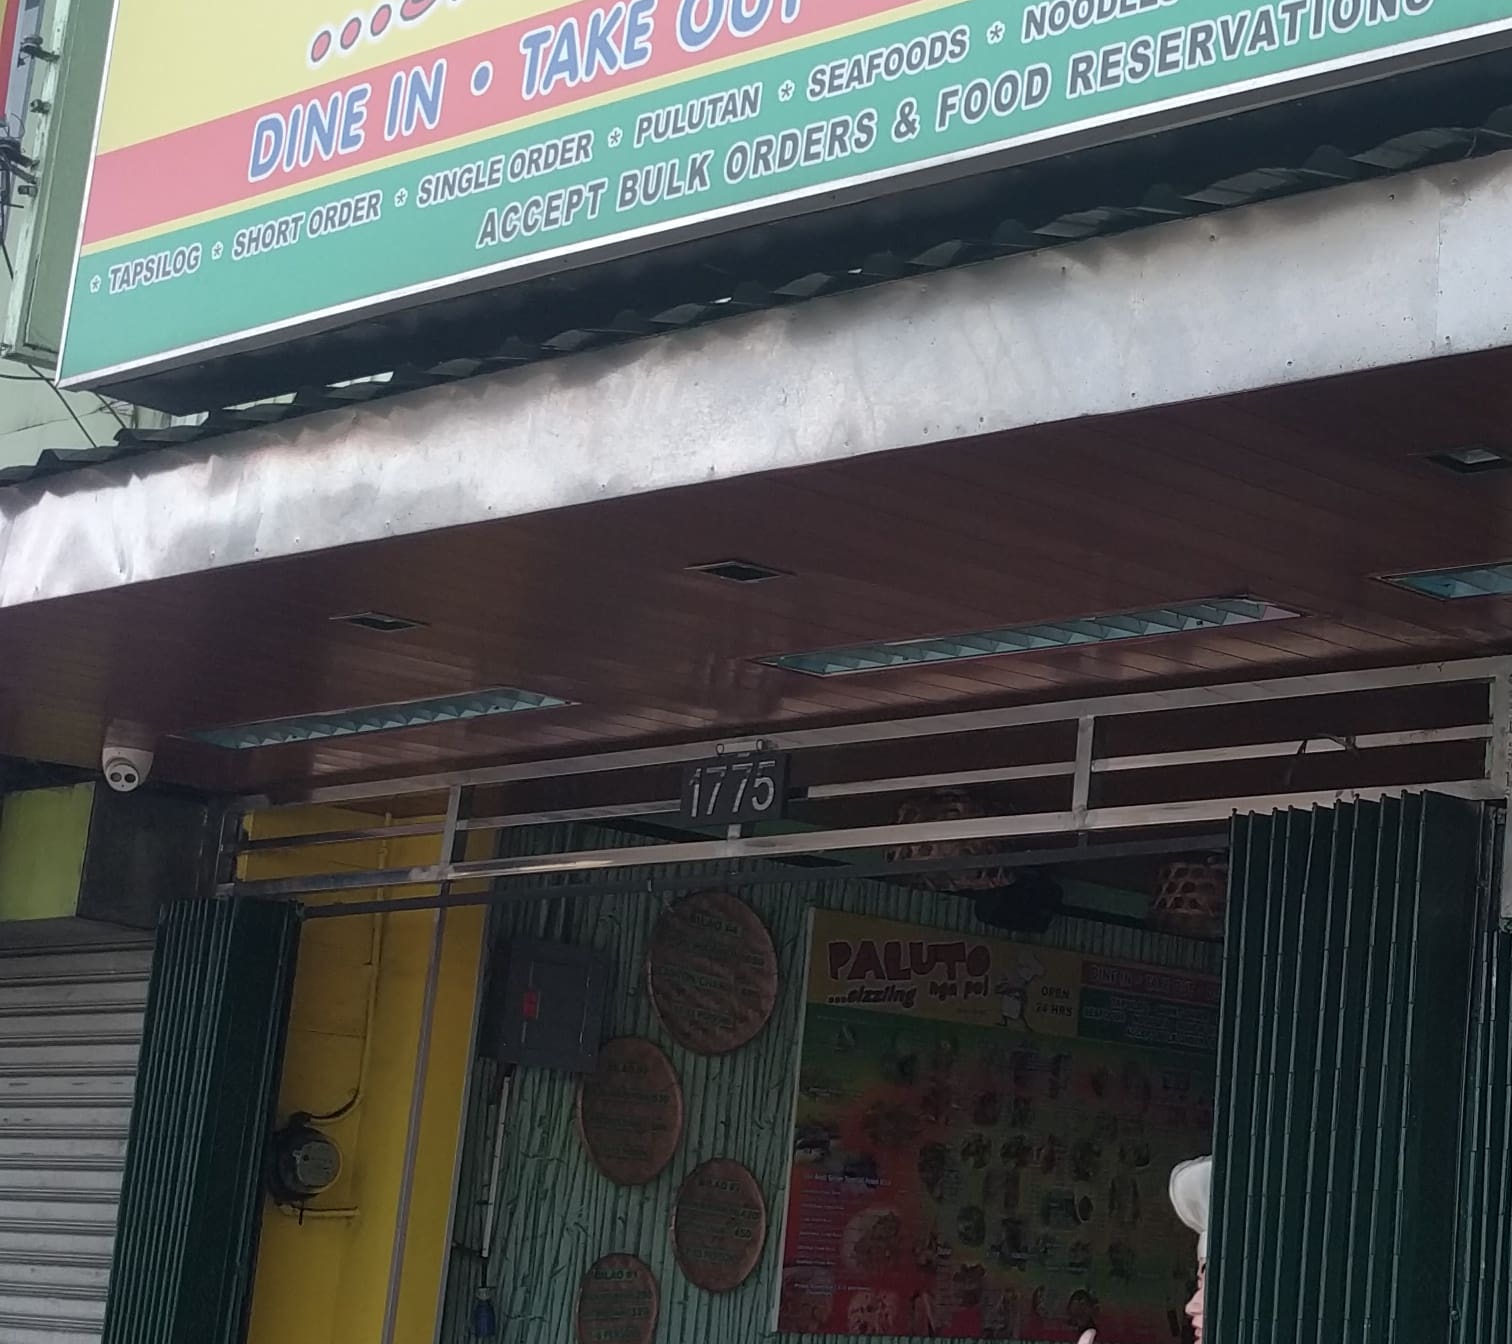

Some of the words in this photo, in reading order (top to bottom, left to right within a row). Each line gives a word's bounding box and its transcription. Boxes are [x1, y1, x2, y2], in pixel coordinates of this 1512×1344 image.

[249, 87, 364, 181] DINE
[388, 60, 444, 134] IN
[109, 244, 201, 292] TAPSILOG
[232, 211, 304, 258] SHORT
[307, 191, 381, 239] ORDER
[417, 160, 503, 206] SINGLE
[506, 132, 593, 186] ORDER
[634, 82, 762, 148] PULUTAN
[808, 27, 968, 100] SEAFOODS
[476, 182, 607, 250] ACCEPT
[615, 150, 710, 211] BULK
[724, 104, 876, 185] ORDERS
[893, 100, 917, 141] &
[936, 72, 1050, 131] FOOD
[689, 760, 776, 818] 1775
[828, 940, 991, 981] PALUTO
[1041, 985, 1070, 1000] OPEN
[1050, 1004, 1073, 1018] HRS
